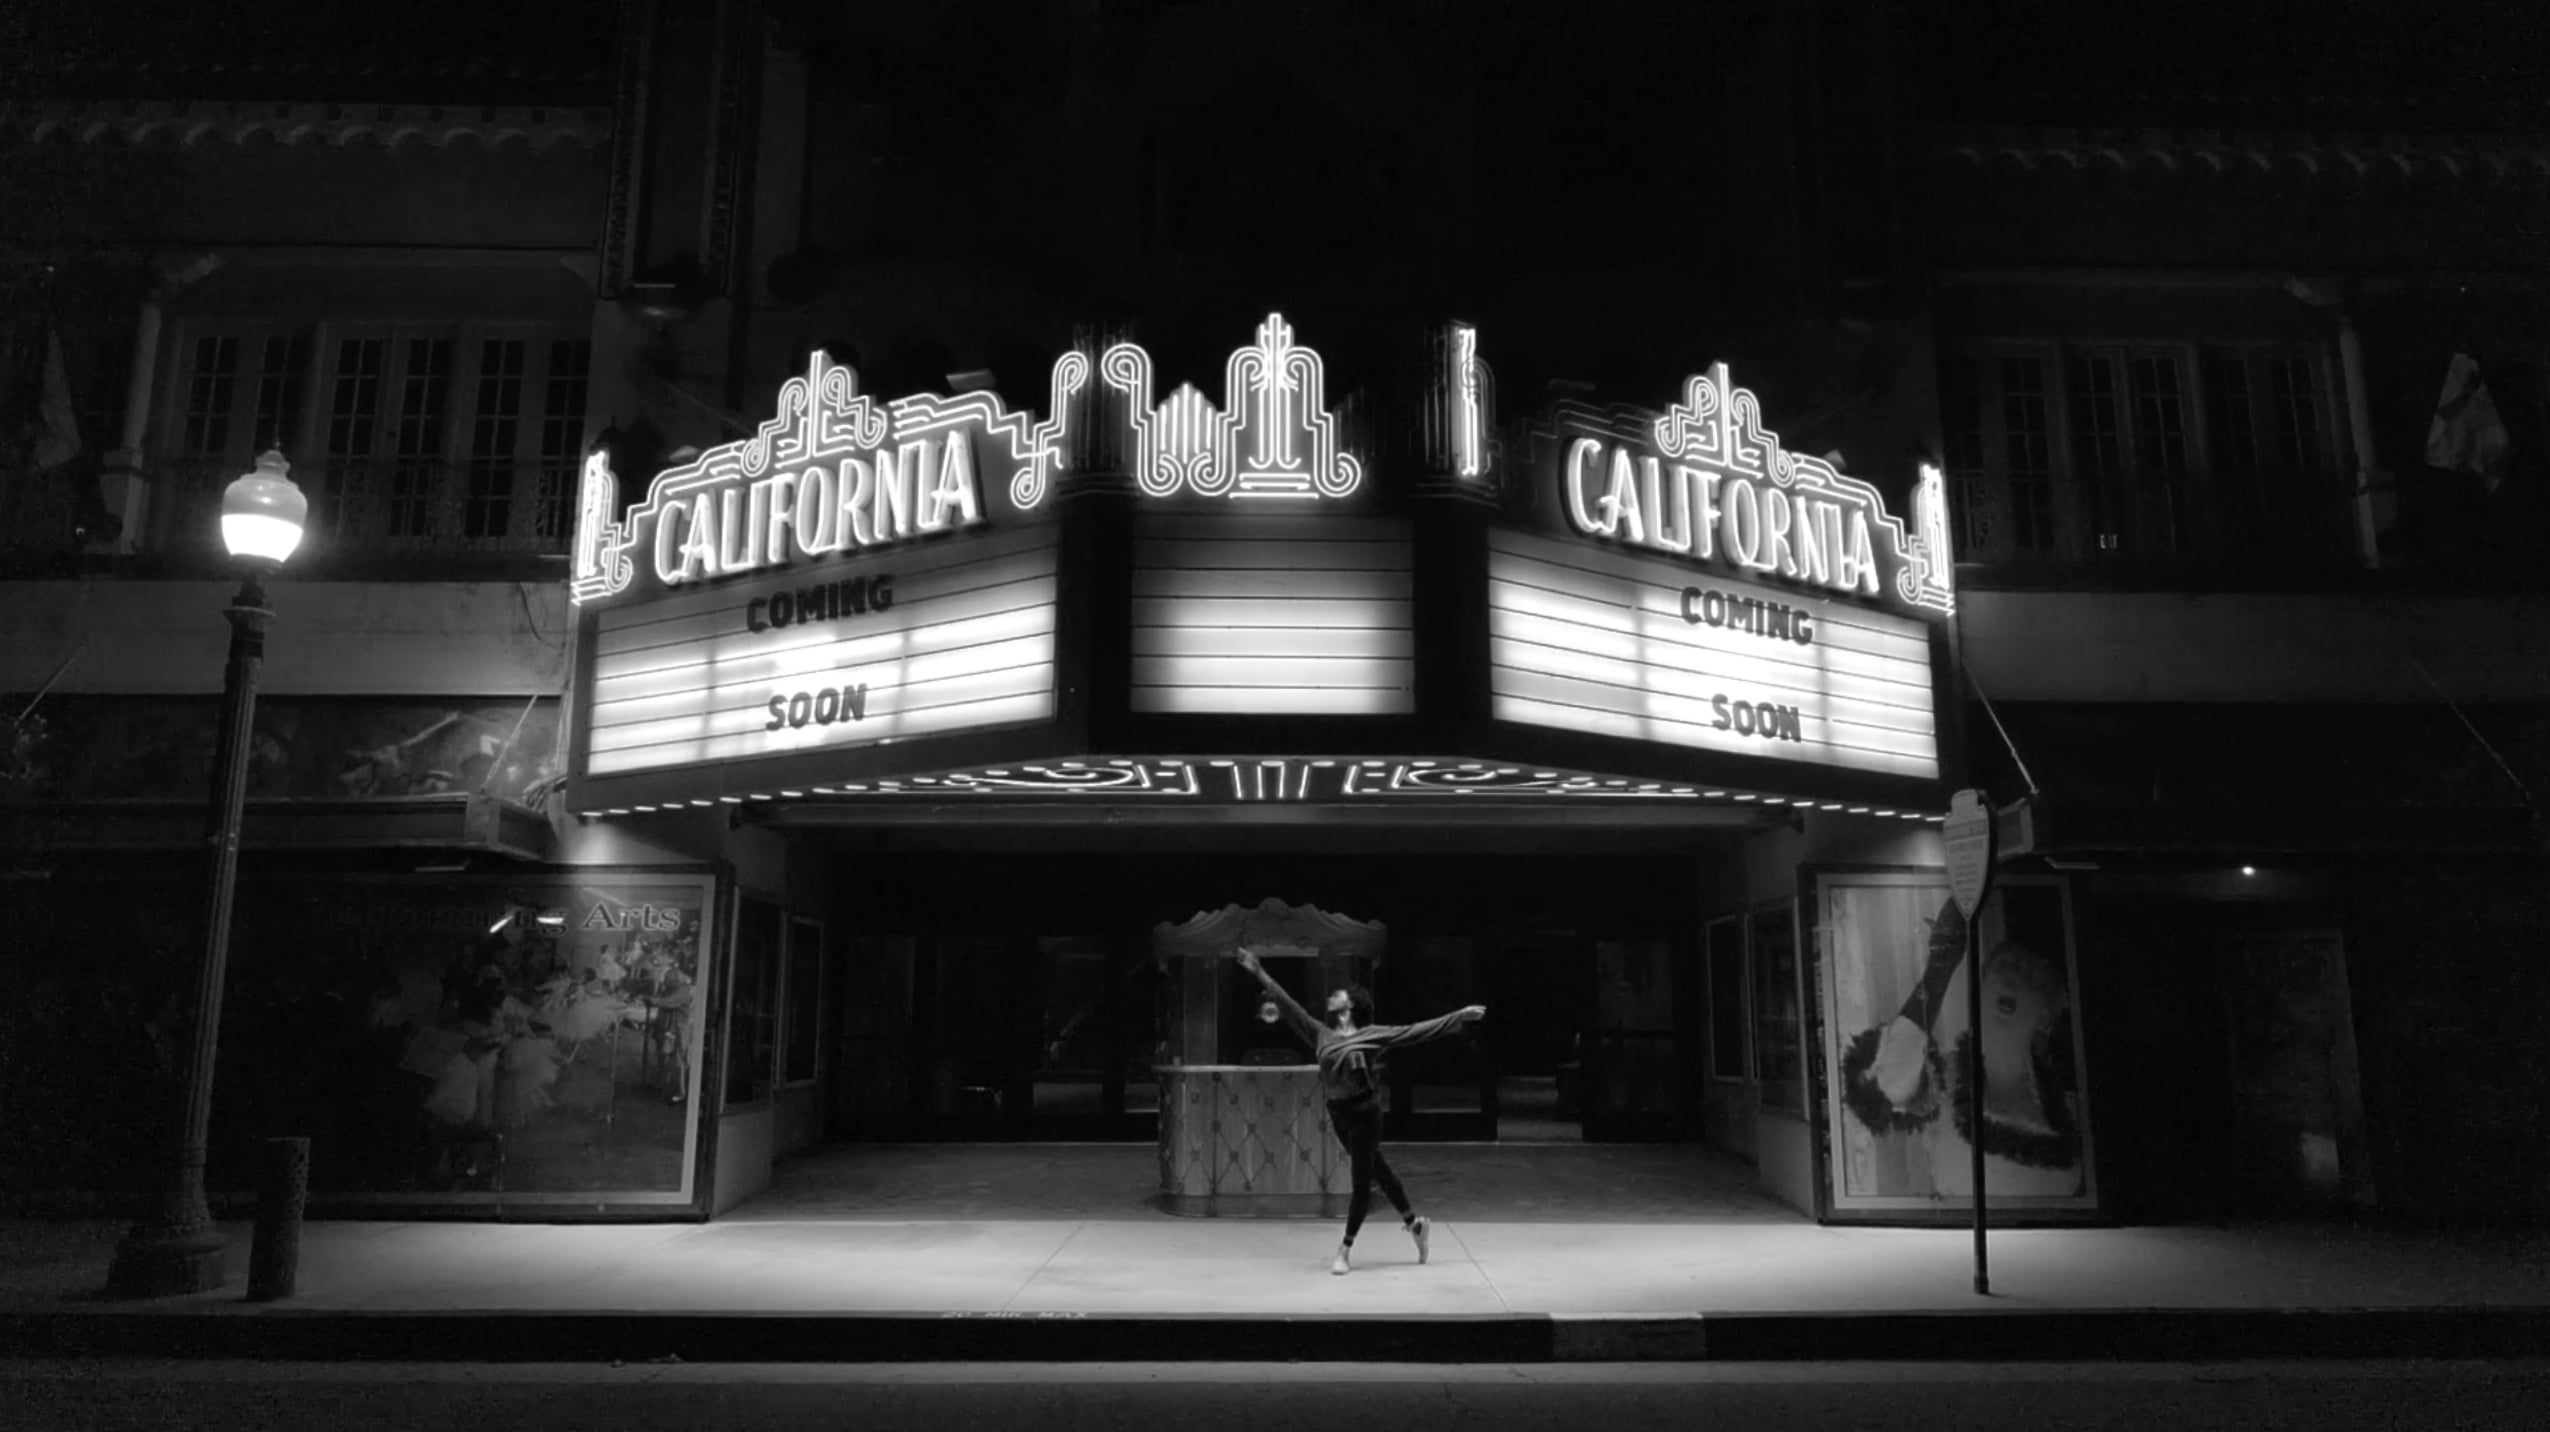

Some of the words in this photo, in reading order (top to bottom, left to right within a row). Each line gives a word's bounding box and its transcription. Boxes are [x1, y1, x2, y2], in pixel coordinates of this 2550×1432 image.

[655, 429, 983, 584] CALIFORNIA
[1565, 437, 1880, 594] CALIFORNIA
[747, 574, 893, 633] COMING
[1681, 586, 1813, 645] COMING
[766, 683, 867, 731] SOON
[1711, 694, 1802, 742] SOON
[579, 901, 681, 931] Arts
